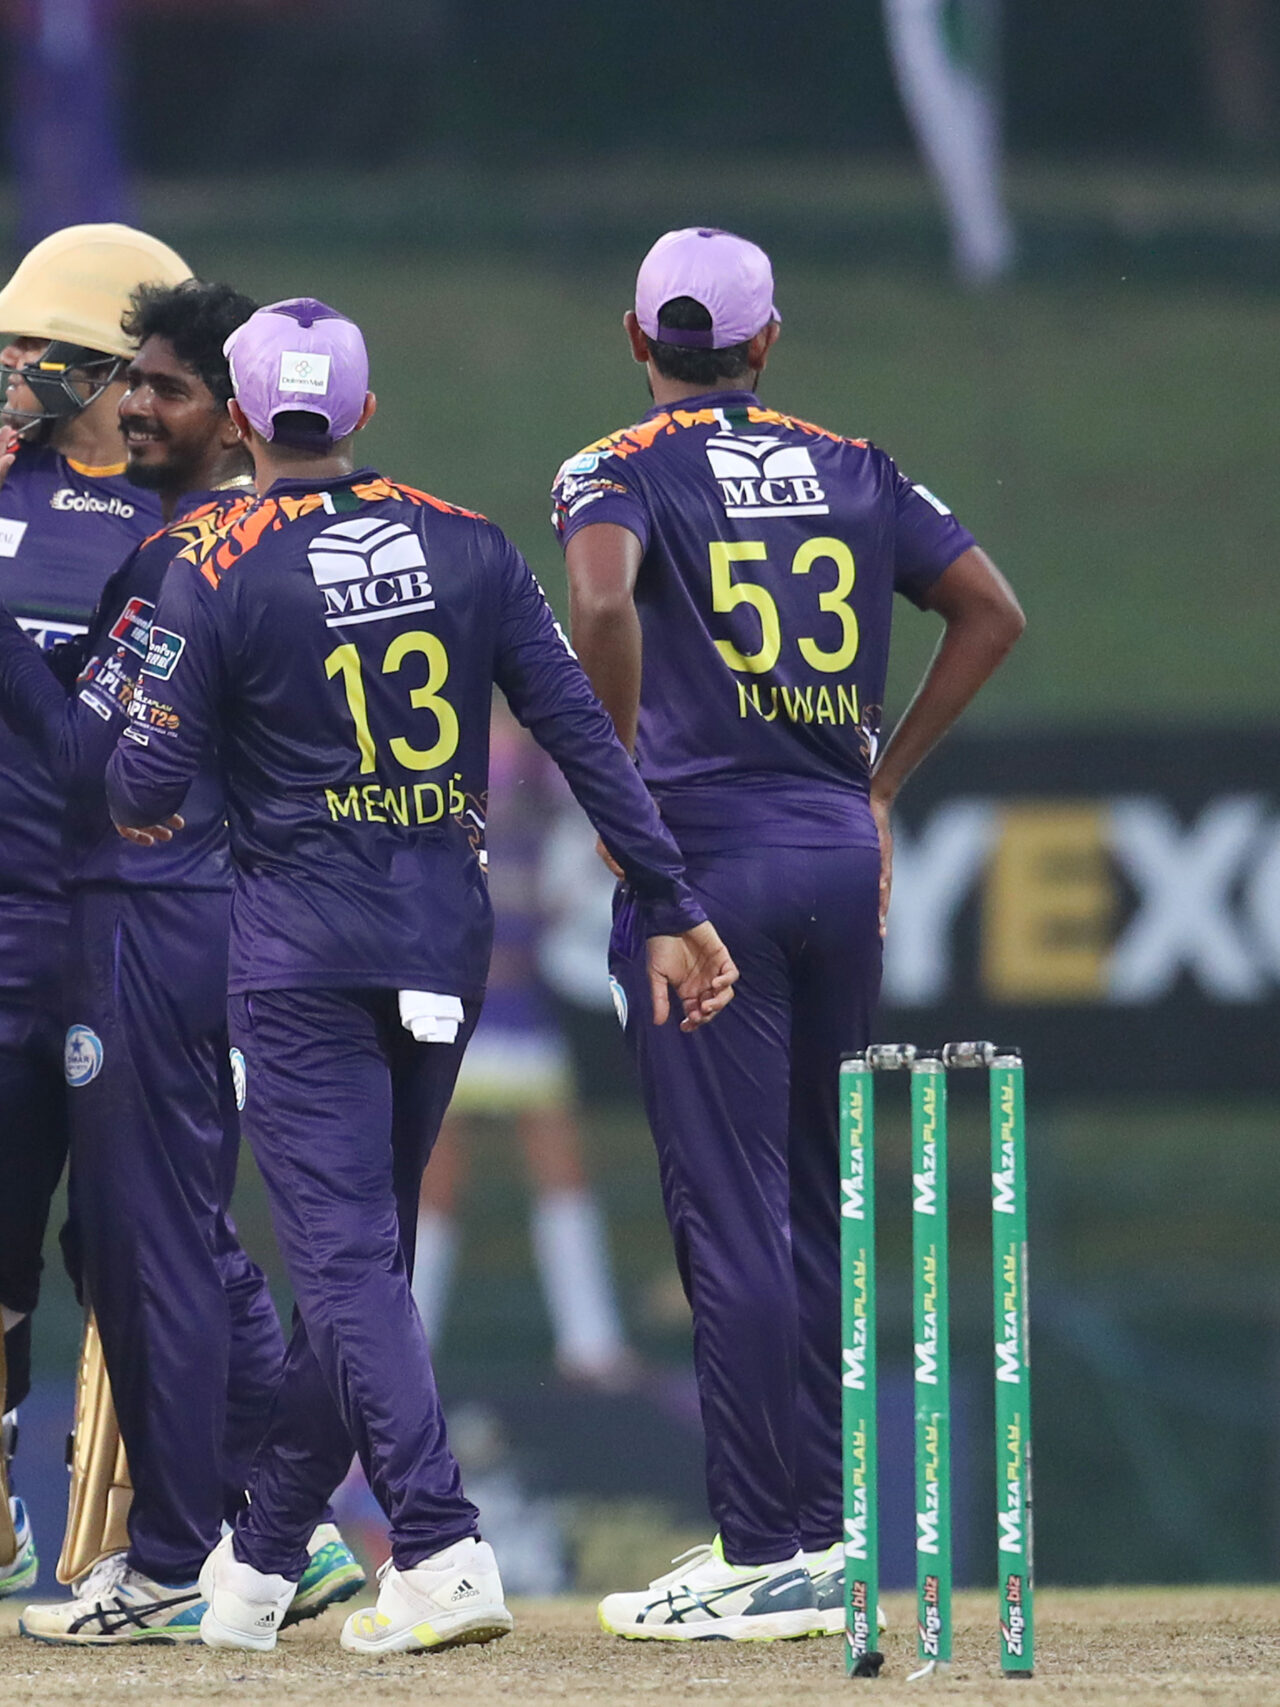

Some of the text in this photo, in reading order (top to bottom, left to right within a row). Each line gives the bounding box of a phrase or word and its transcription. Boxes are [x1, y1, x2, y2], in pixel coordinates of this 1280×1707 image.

[718, 477, 826, 506] MCB
[320, 571, 433, 615] MCB
[709, 537, 859, 674] 53
[324, 630, 459, 775] 13
[736, 680, 860, 725] NUWAN
[451, 1588, 480, 1602] adidas
